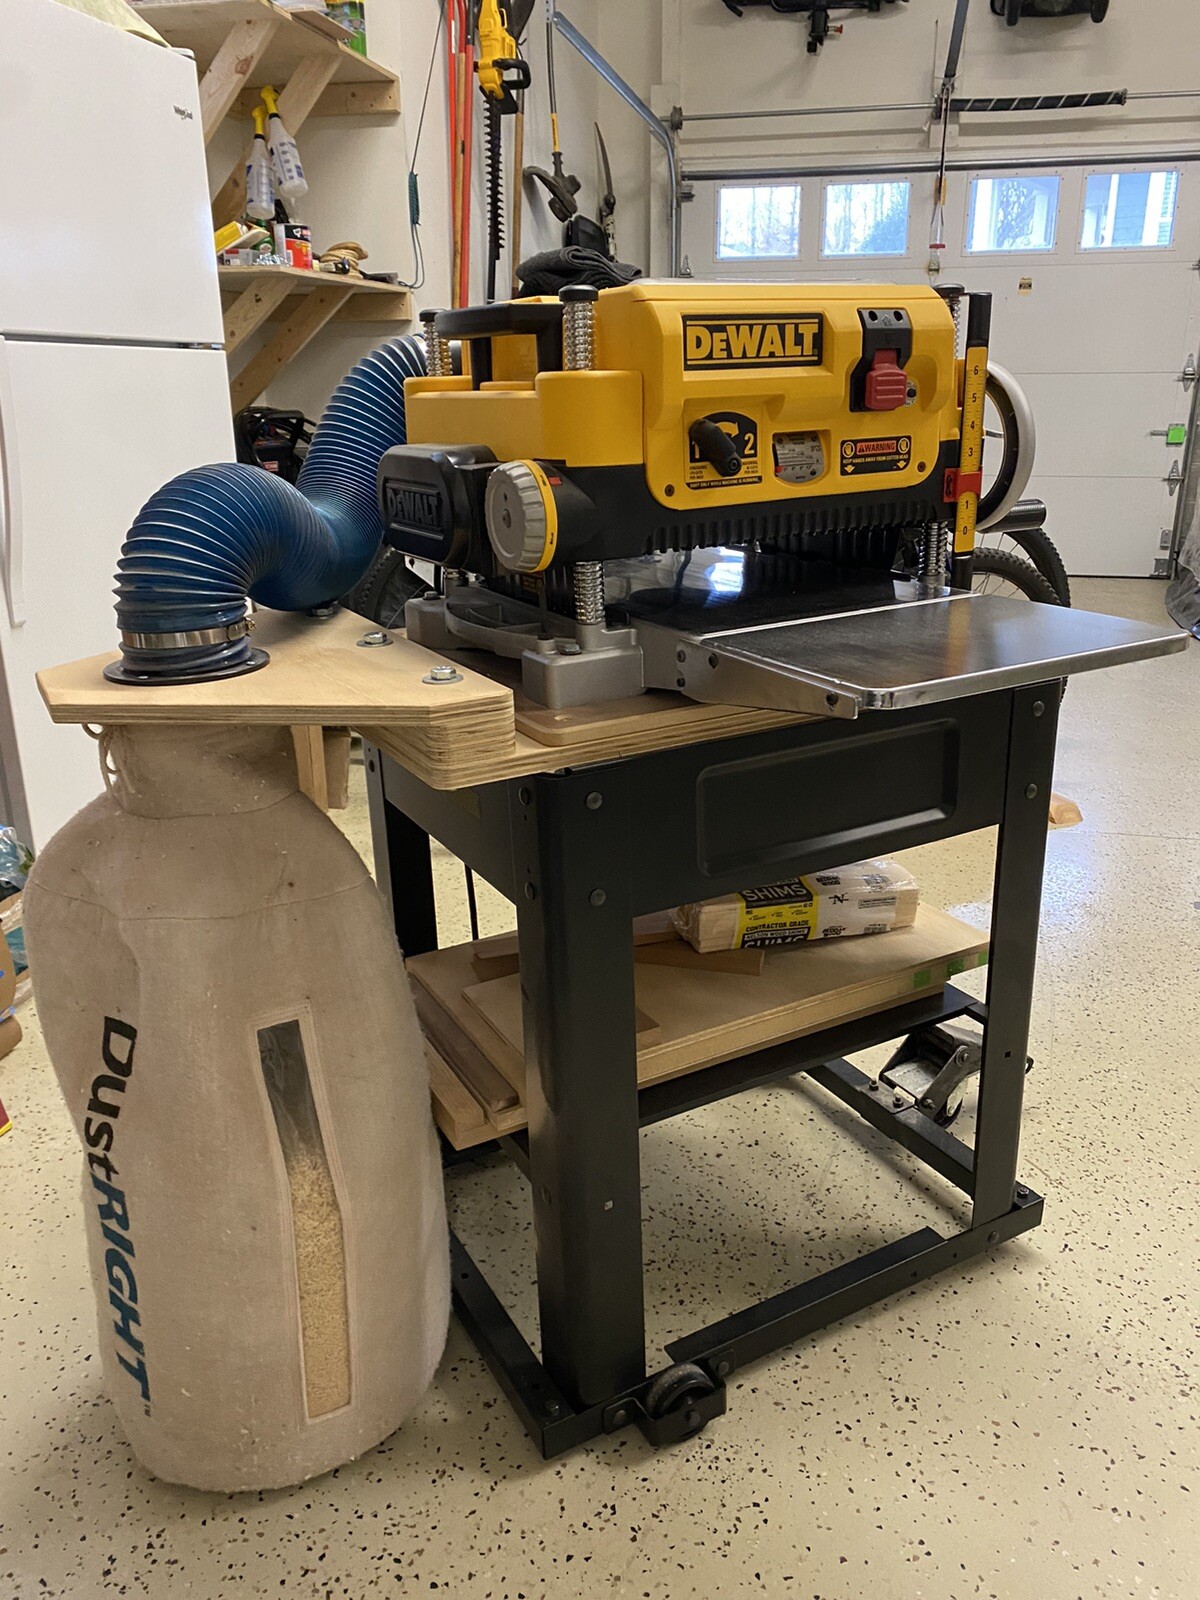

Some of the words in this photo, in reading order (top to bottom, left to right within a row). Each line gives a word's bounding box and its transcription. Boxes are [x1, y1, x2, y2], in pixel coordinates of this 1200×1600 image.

[973, 364, 979, 376] 6
[972, 392, 977, 403] 5
[970, 420, 975, 430] 4
[744, 432, 755, 455] 2
[864, 441, 896, 453] WARNING
[968, 447, 974, 457] 3
[962, 525, 967, 536] 0
[742, 884, 807, 901] SHIMS
[745, 921, 787, 932] CONTRACTOR
